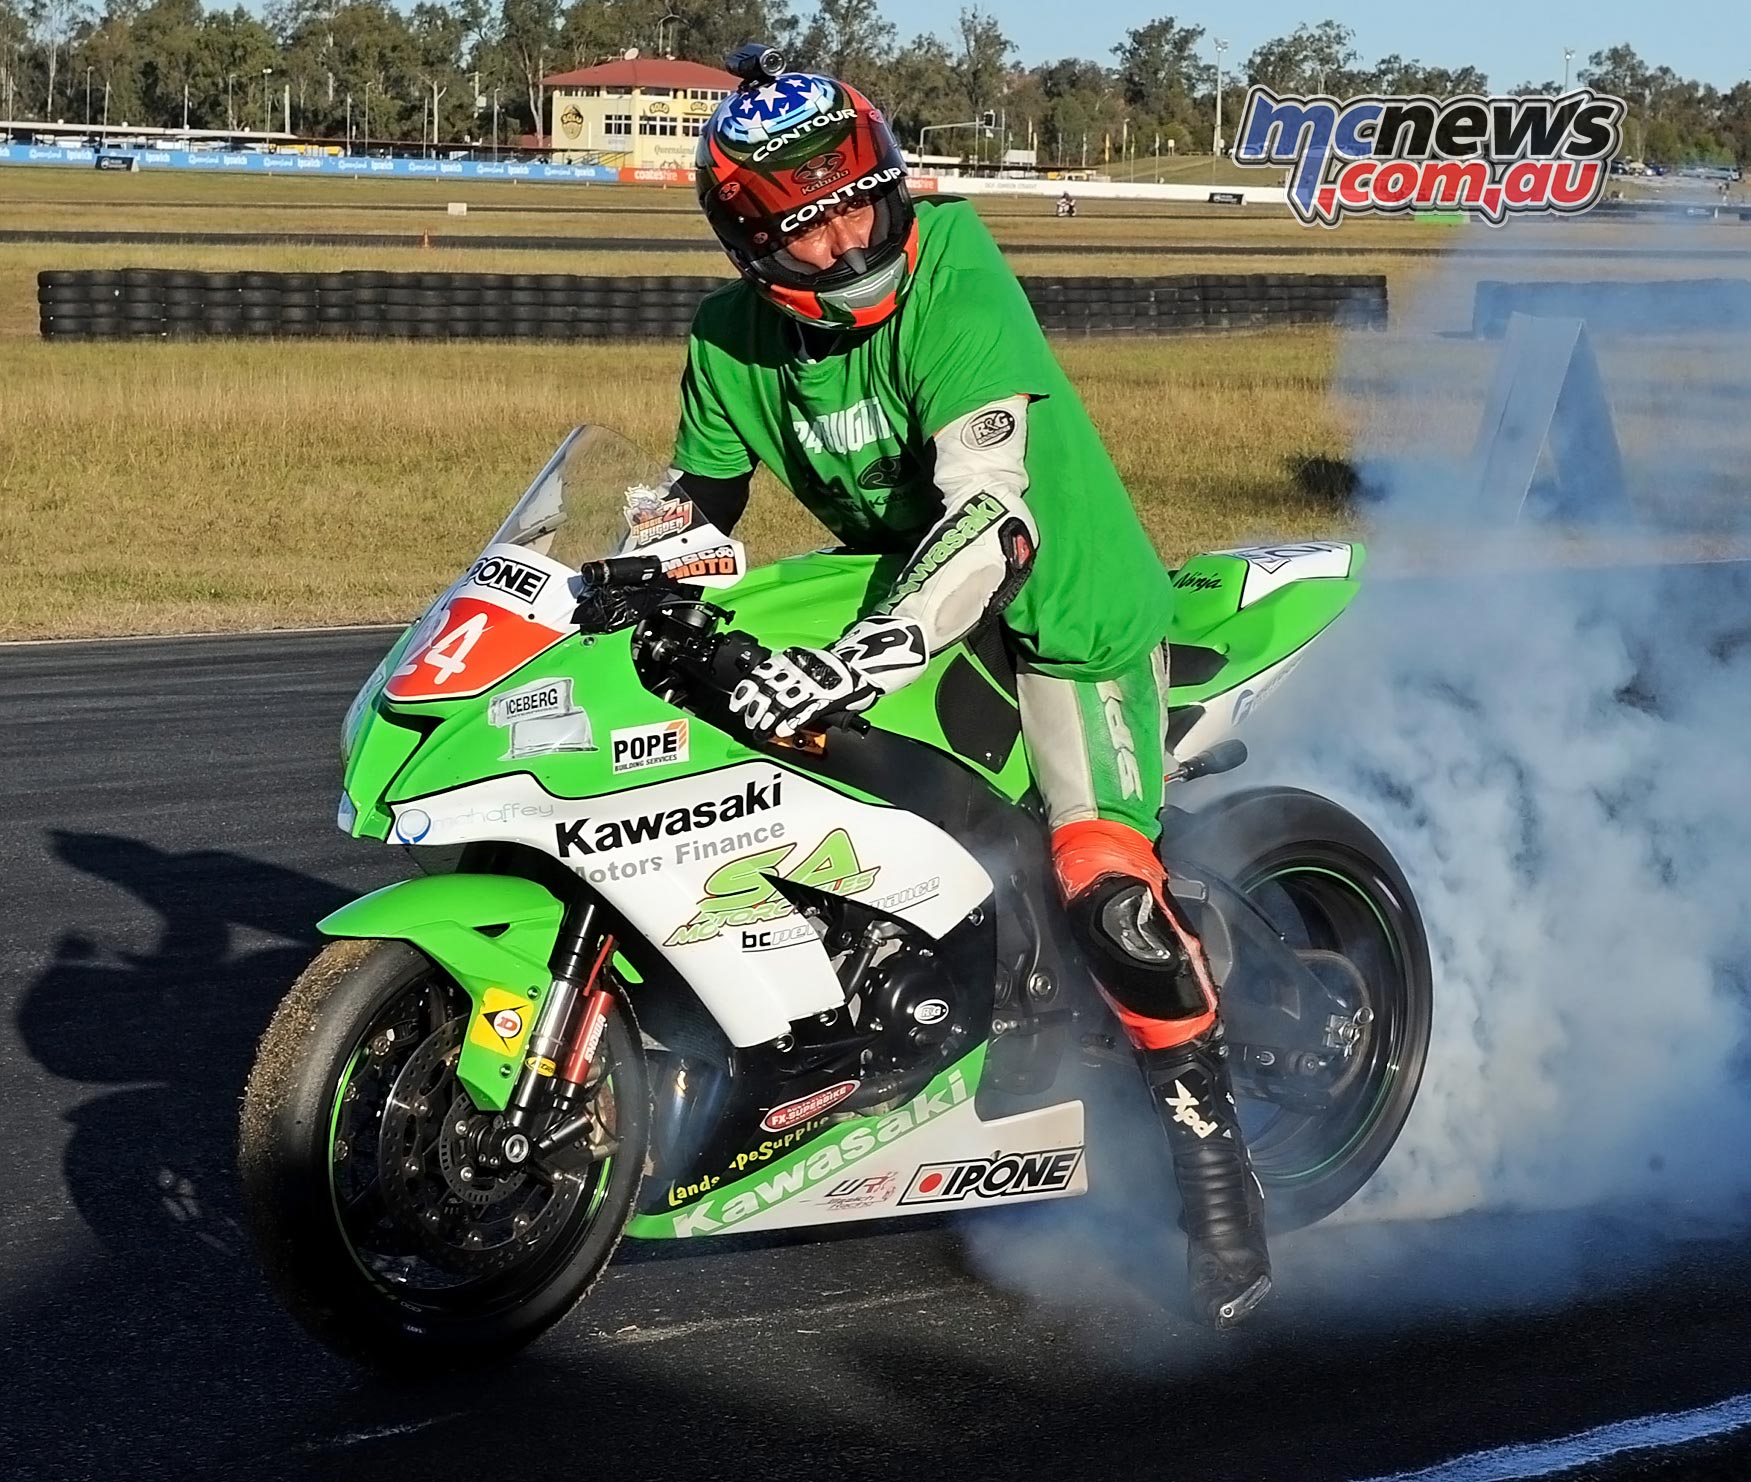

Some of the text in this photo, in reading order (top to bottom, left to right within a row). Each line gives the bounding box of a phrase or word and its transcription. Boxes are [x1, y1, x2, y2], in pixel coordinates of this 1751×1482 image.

[650, 102, 669, 114] SOLO
[691, 102, 707, 112] SOLO
[752, 108, 858, 163] CONTOUR
[780, 167, 902, 233] CONTOUR
[470, 560, 543, 599] PONE
[667, 558, 734, 579] MOTO
[1174, 572, 1222, 593] Ninja
[505, 688, 558, 716] ICEBERG
[614, 731, 677, 763] POPE
[614, 754, 677, 772] BUILDING SERVICES
[555, 772, 782, 858] Kawasaki
[675, 822, 785, 864] Finance
[672, 1071, 970, 1238] Kawasaki
[942, 1152, 1072, 1196] IPONE
